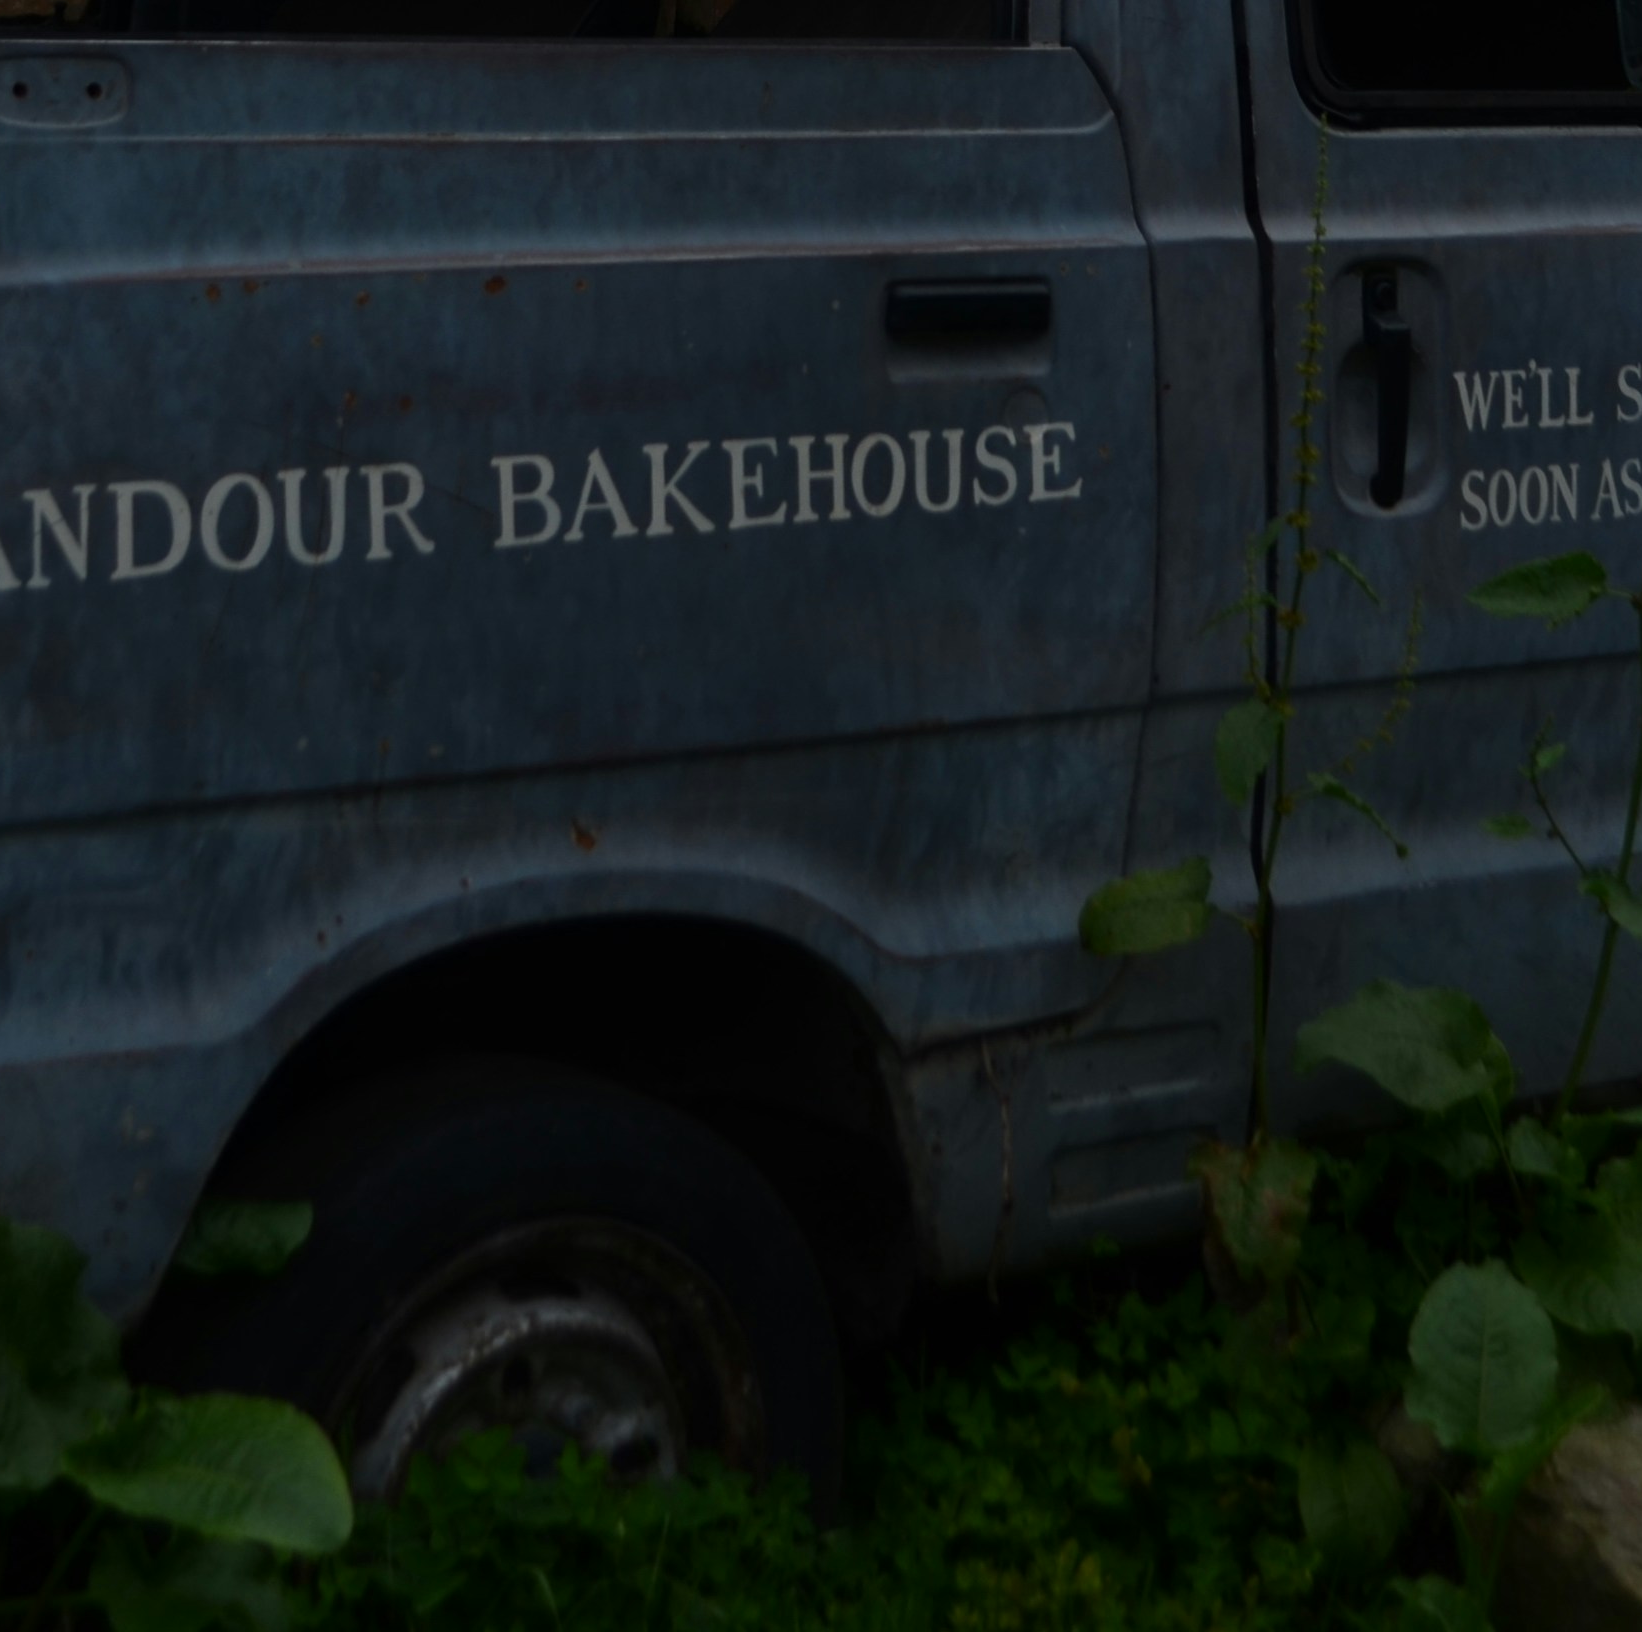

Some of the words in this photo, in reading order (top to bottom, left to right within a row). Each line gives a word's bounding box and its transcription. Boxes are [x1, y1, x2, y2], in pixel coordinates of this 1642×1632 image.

[1453, 358, 1595, 432] WE'LL
[490, 421, 1082, 548] BAKEHOUSE
[1460, 463, 1579, 531] SOON
